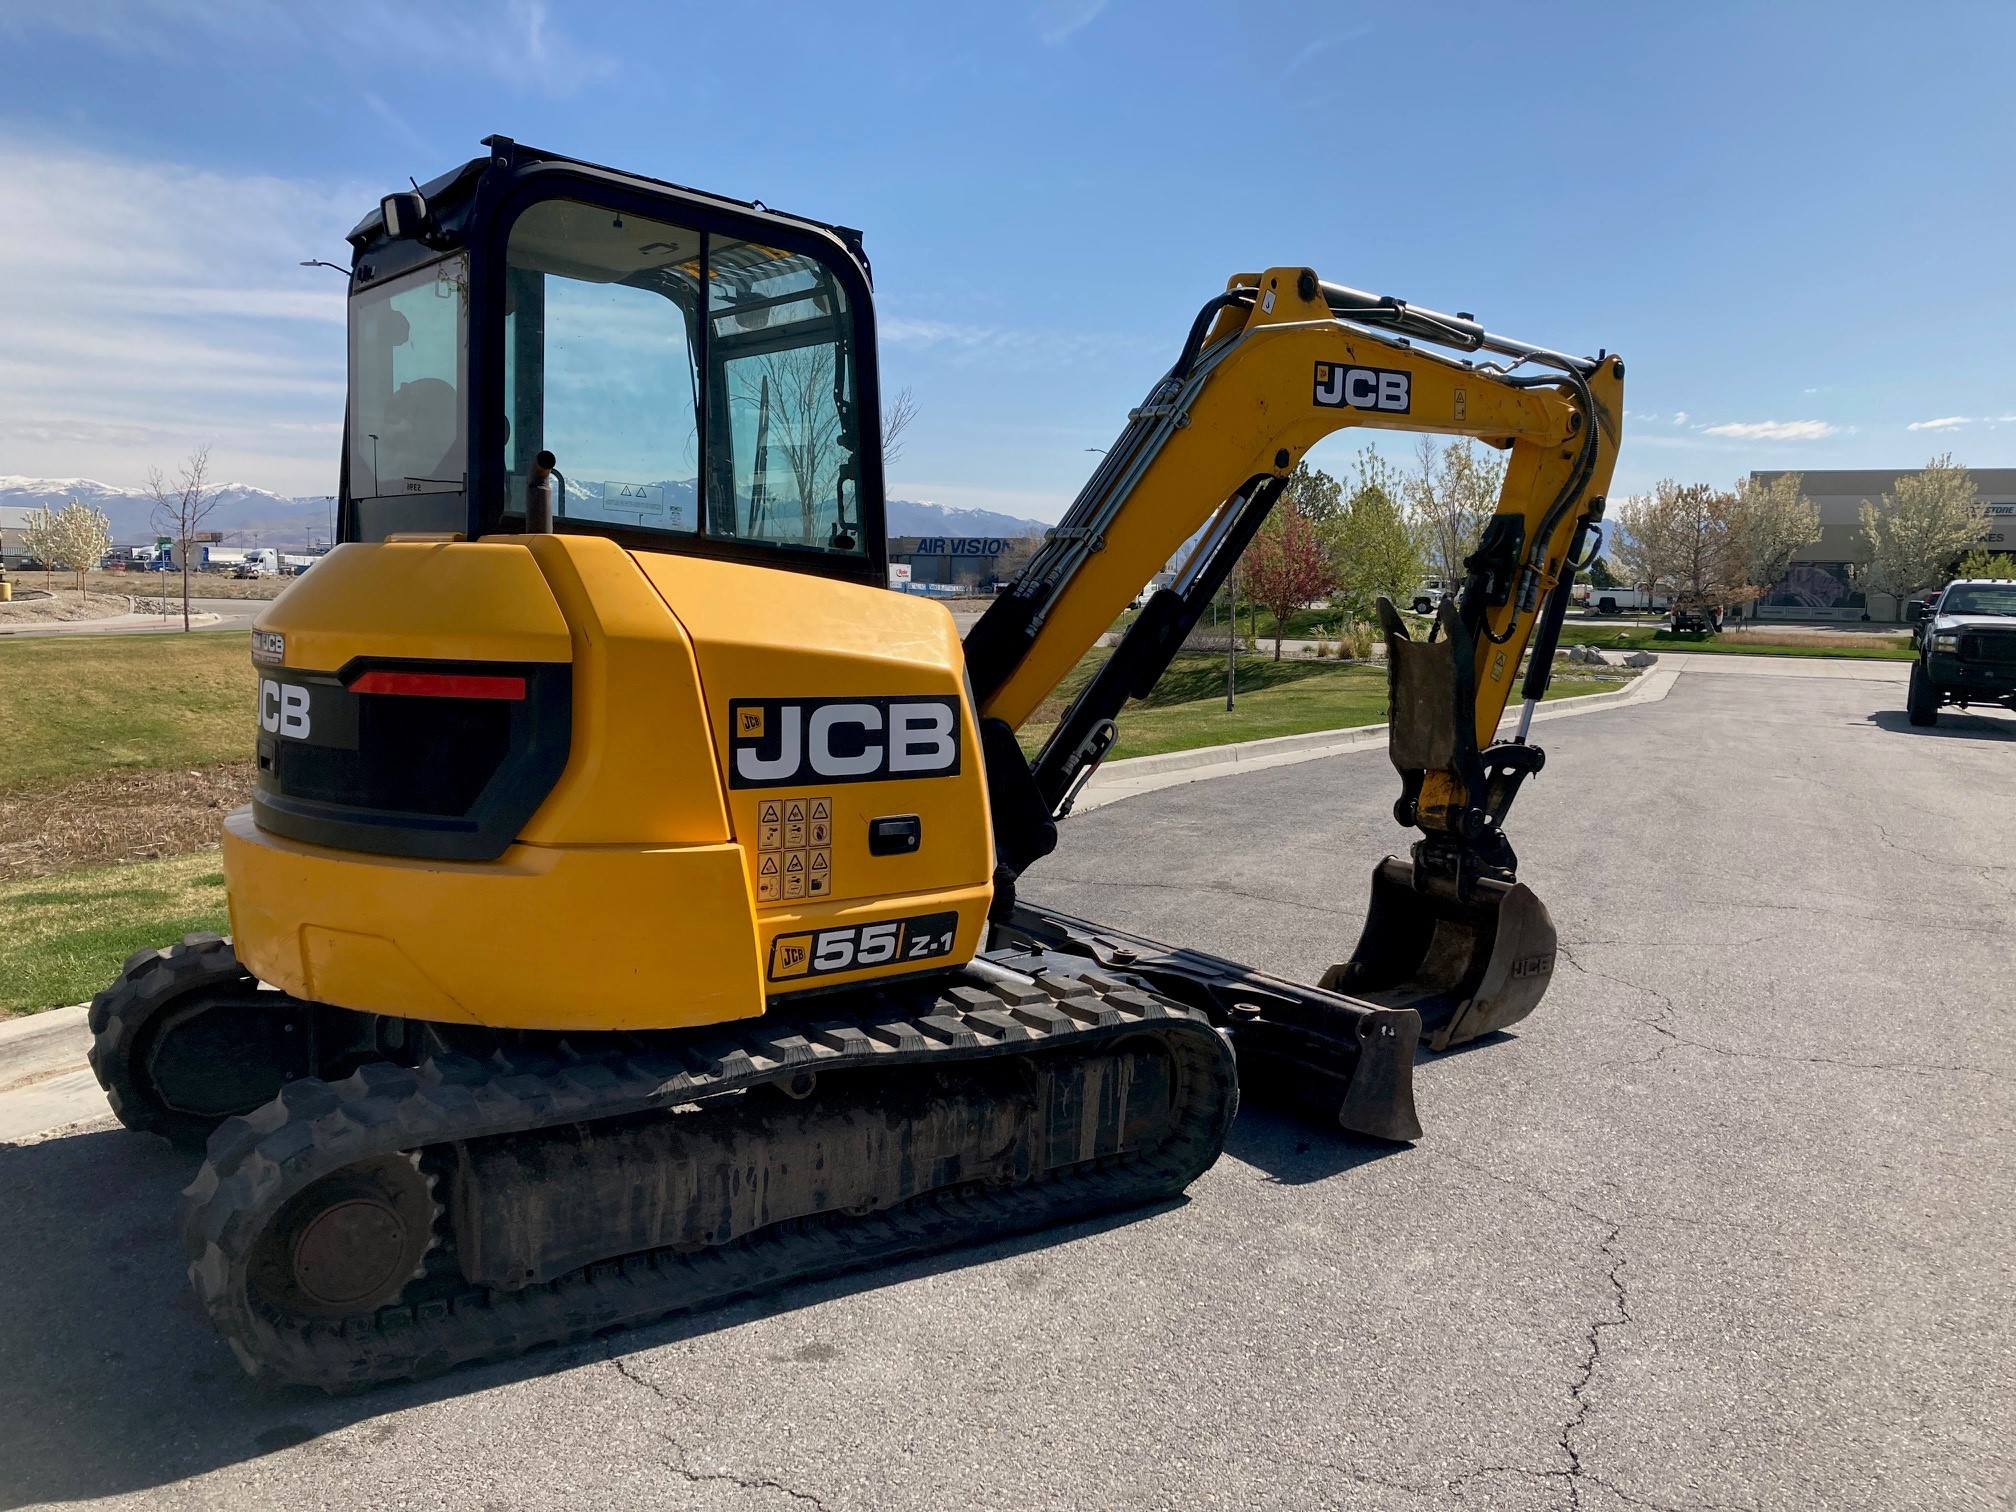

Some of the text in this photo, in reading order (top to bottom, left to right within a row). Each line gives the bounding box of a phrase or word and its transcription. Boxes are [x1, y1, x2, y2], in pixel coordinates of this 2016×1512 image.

[1316, 367, 1409, 410] JCB
[917, 538, 946, 553] AIR
[741, 713, 761, 730] JCB
[736, 703, 956, 780] JCB
[783, 946, 805, 968] JCB
[813, 923, 954, 971] 55 Z-1
[1512, 956, 1552, 978] JCB
